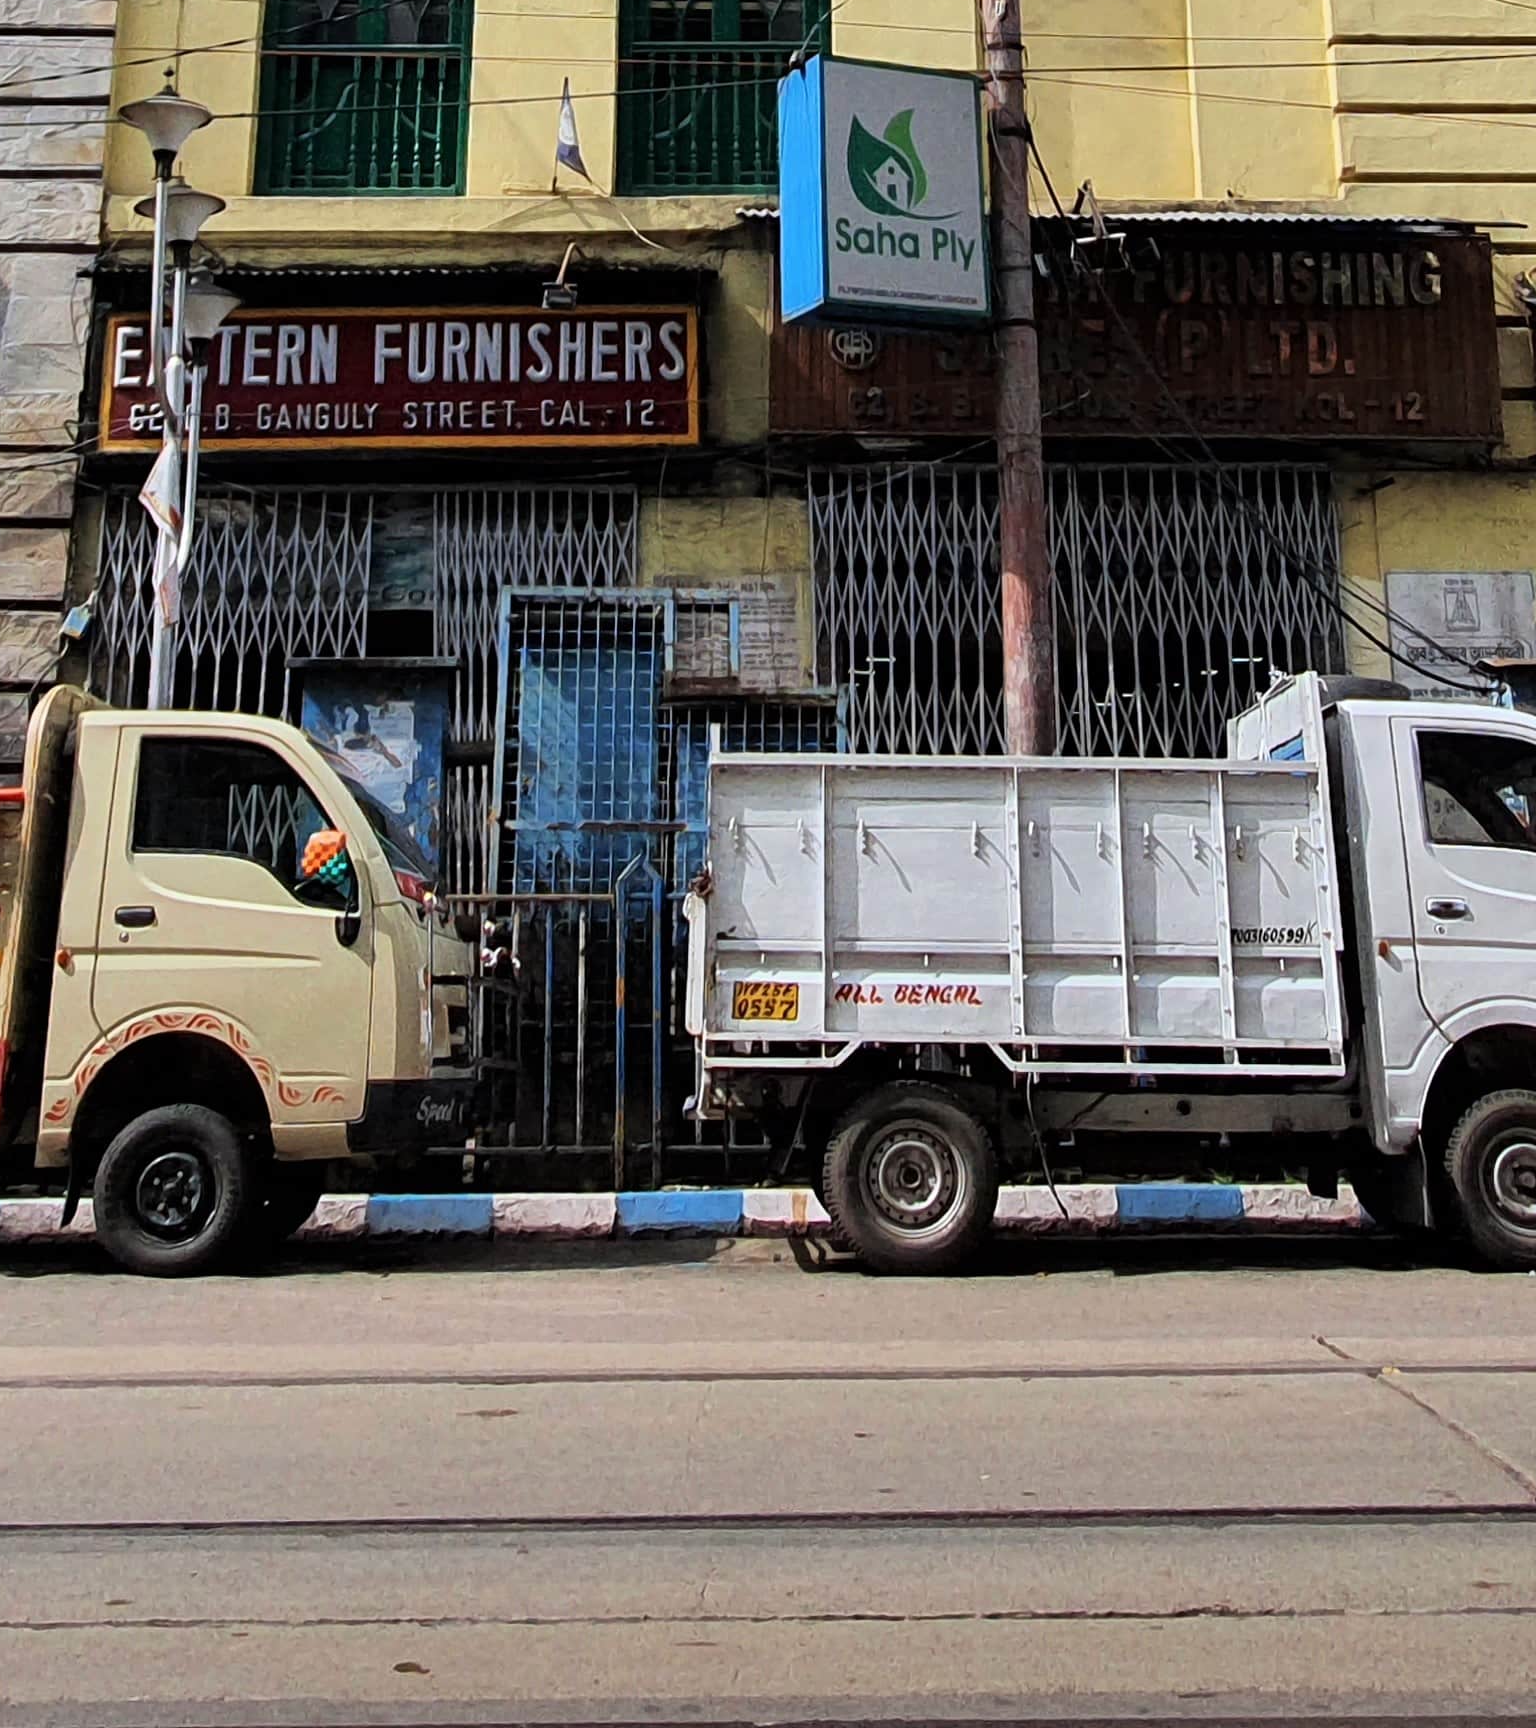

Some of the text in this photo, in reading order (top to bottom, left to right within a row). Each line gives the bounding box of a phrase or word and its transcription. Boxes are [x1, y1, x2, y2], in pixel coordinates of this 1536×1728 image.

[835, 217, 976, 272] Saha Ply
[114, 320, 686, 387] ETERN FURNISHERS
[257, 402, 379, 431] GANGULY
[834, 983, 984, 1006] ALL BENGAL
